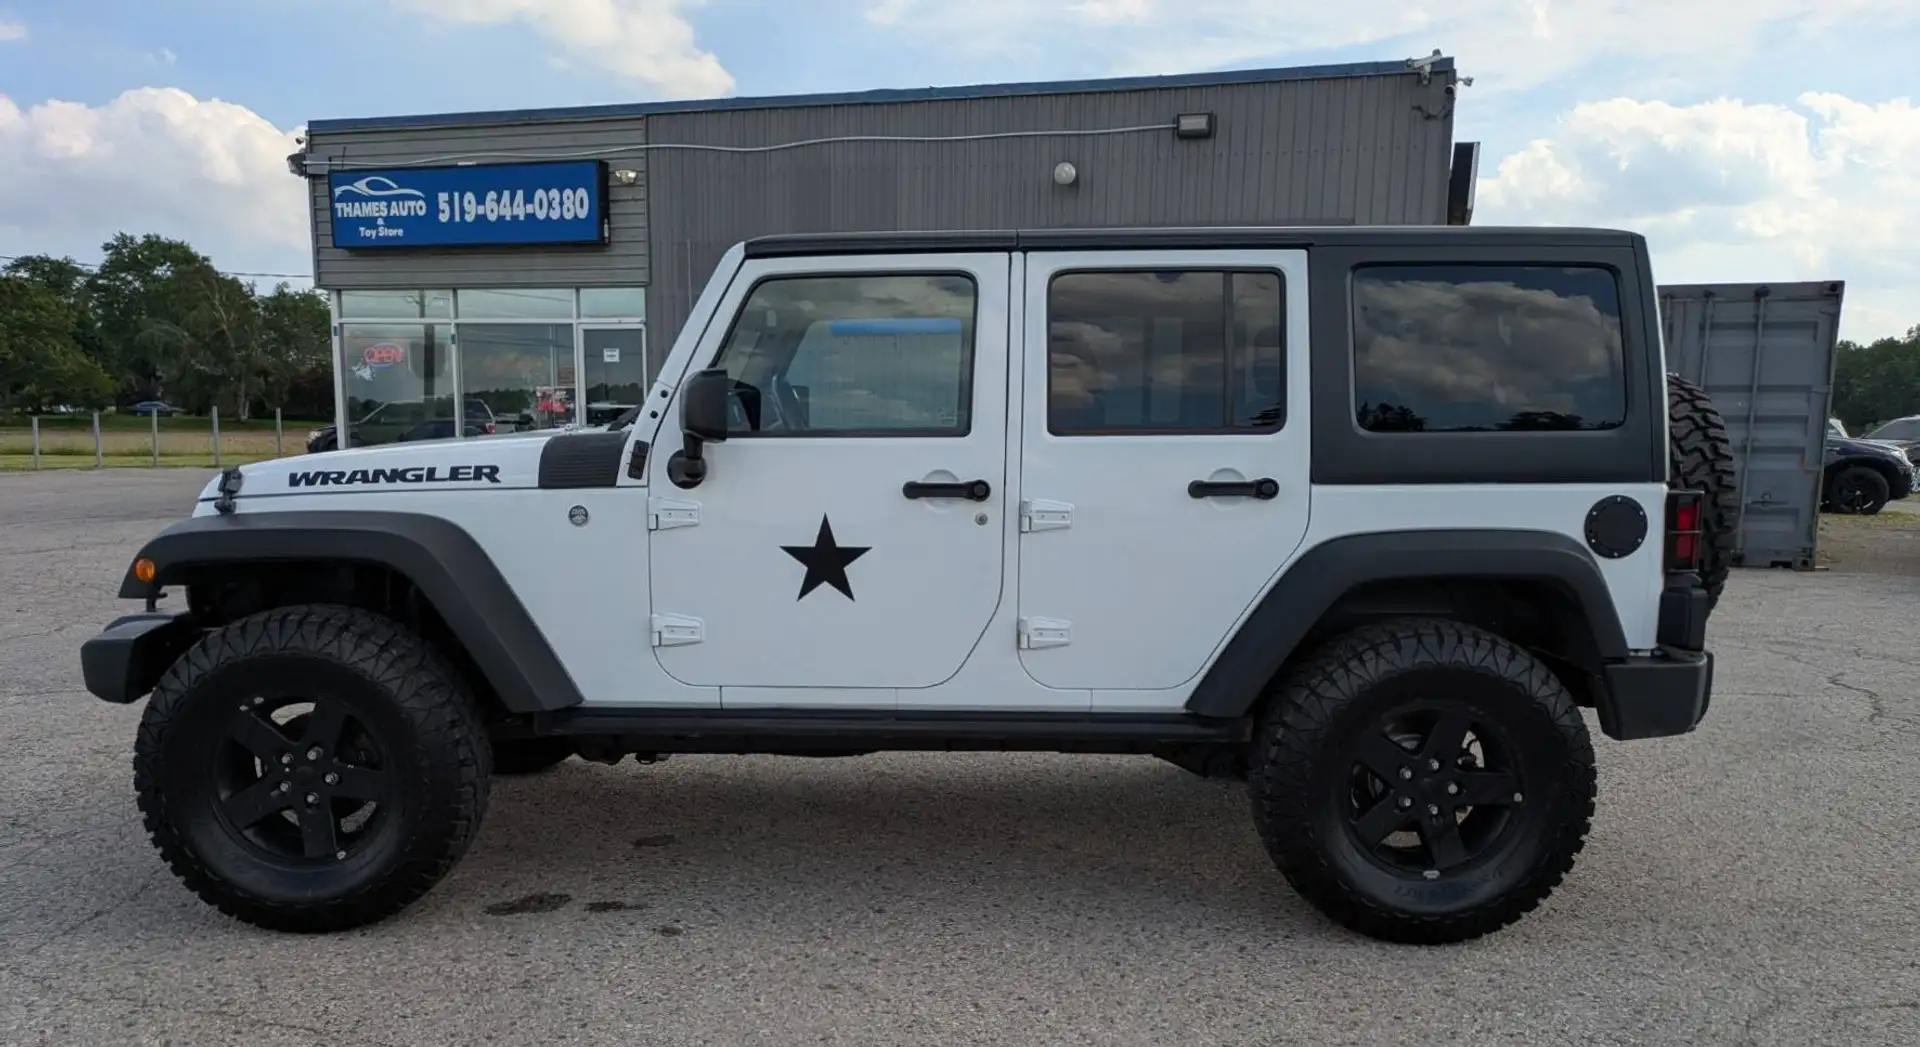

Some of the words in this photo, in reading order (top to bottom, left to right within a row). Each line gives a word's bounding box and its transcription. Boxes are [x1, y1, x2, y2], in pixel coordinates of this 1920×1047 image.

[335, 201, 388, 218] THAMES
[389, 199, 427, 217] AUTO
[437, 187, 590, 223] 519-644-0380
[358, 227, 377, 239] Toy
[378, 226, 404, 237] Store
[365, 347, 404, 364] OPEN
[288, 464, 502, 488] WRANGLER
